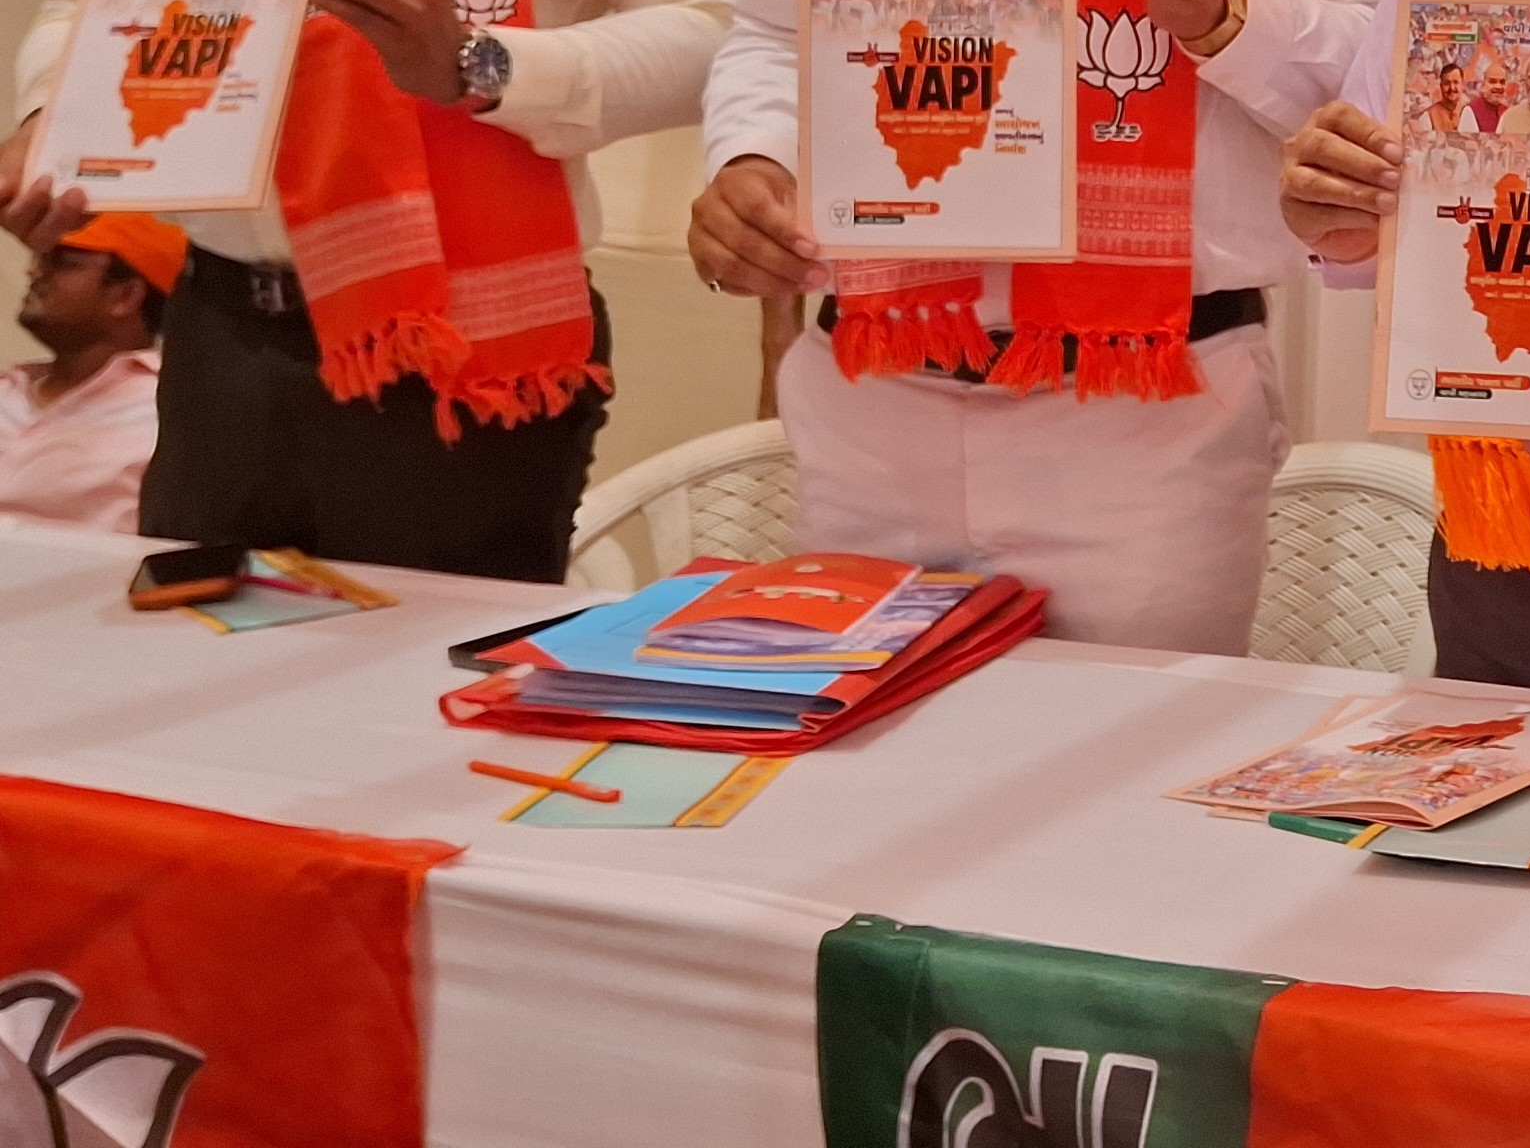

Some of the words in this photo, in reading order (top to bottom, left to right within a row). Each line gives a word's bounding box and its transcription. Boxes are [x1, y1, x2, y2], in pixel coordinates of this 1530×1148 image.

[172, 12, 241, 36] VISION
[139, 37, 234, 77] VAPI
[913, 37, 993, 64] VISION
[883, 65, 993, 110] VAPI
